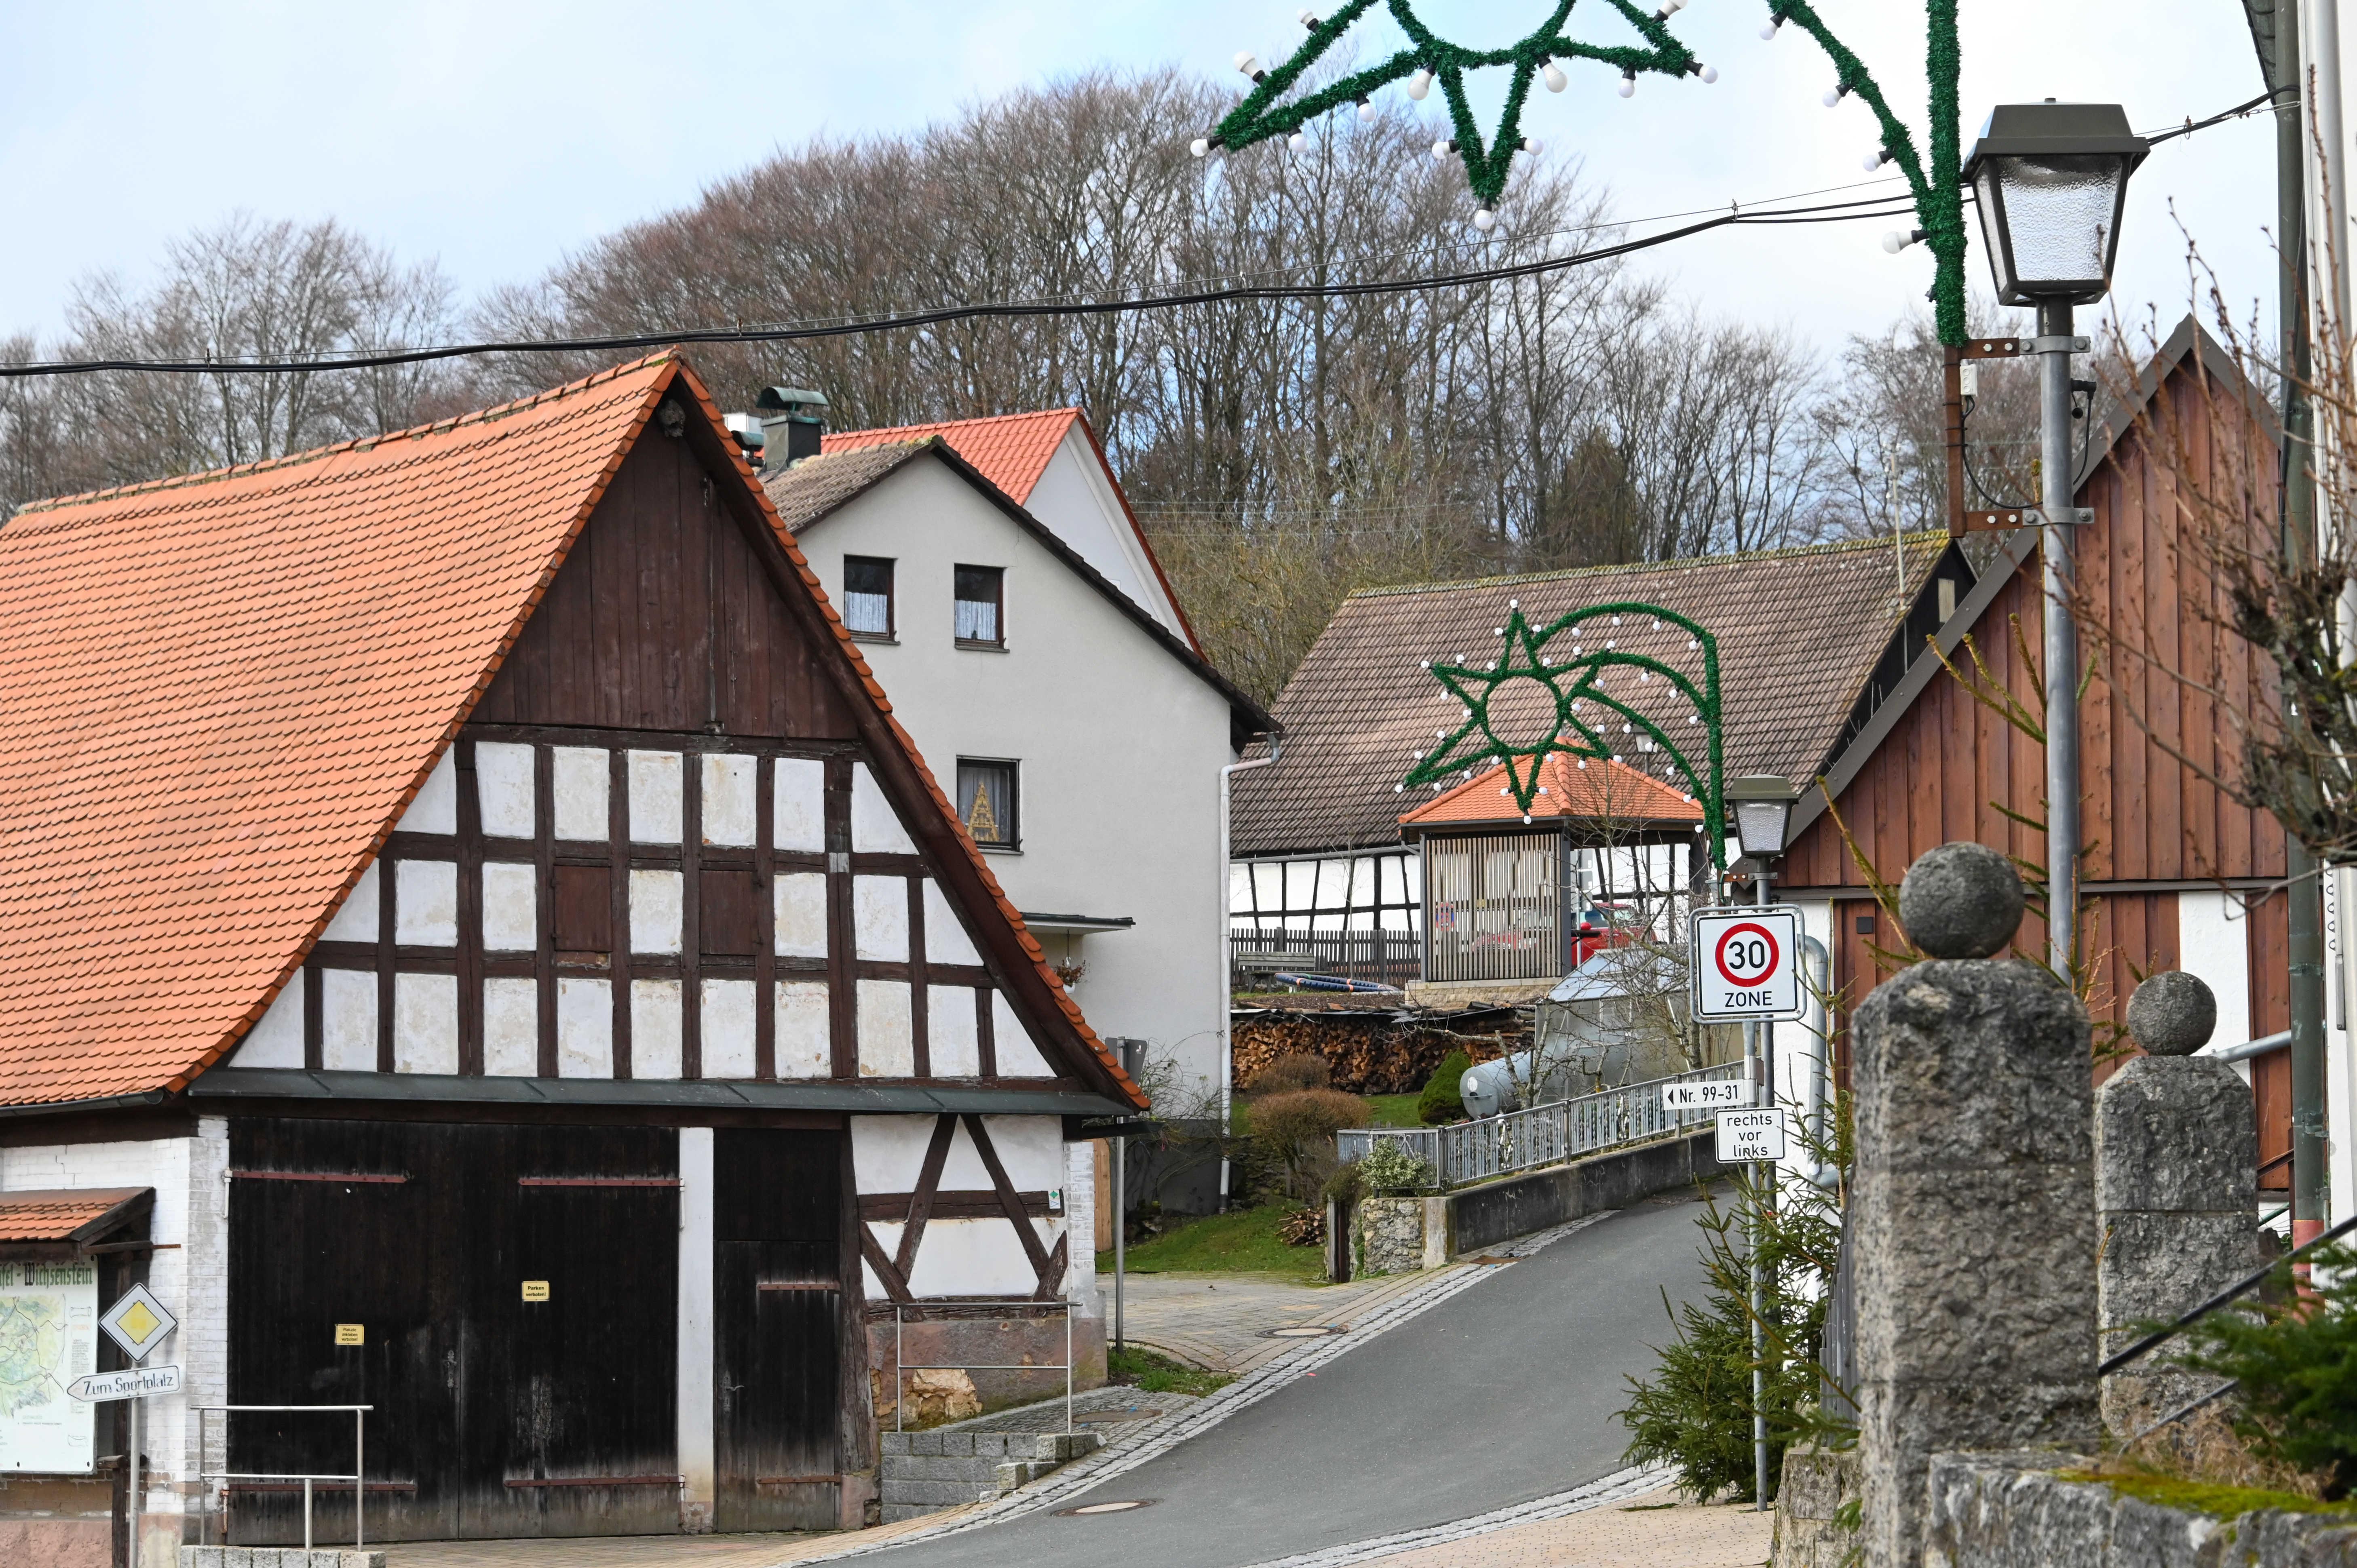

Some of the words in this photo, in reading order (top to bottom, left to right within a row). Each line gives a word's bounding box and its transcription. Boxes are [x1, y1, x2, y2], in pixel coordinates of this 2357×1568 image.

[1729, 940, 1765, 969] 30
[1725, 991, 1772, 1007] ZONE
[1680, 1088, 1696, 1103] Nr.
[1703, 1085, 1738, 1101] 99-31
[1727, 1114, 1772, 1126] rechts
[1739, 1132, 1762, 1141] vor
[1734, 1144, 1768, 1157] links
[24, 1262, 93, 1289] Wichsenstein
[84, 1380, 112, 1396] Zum
[115, 1373, 174, 1393] Sportplatz
